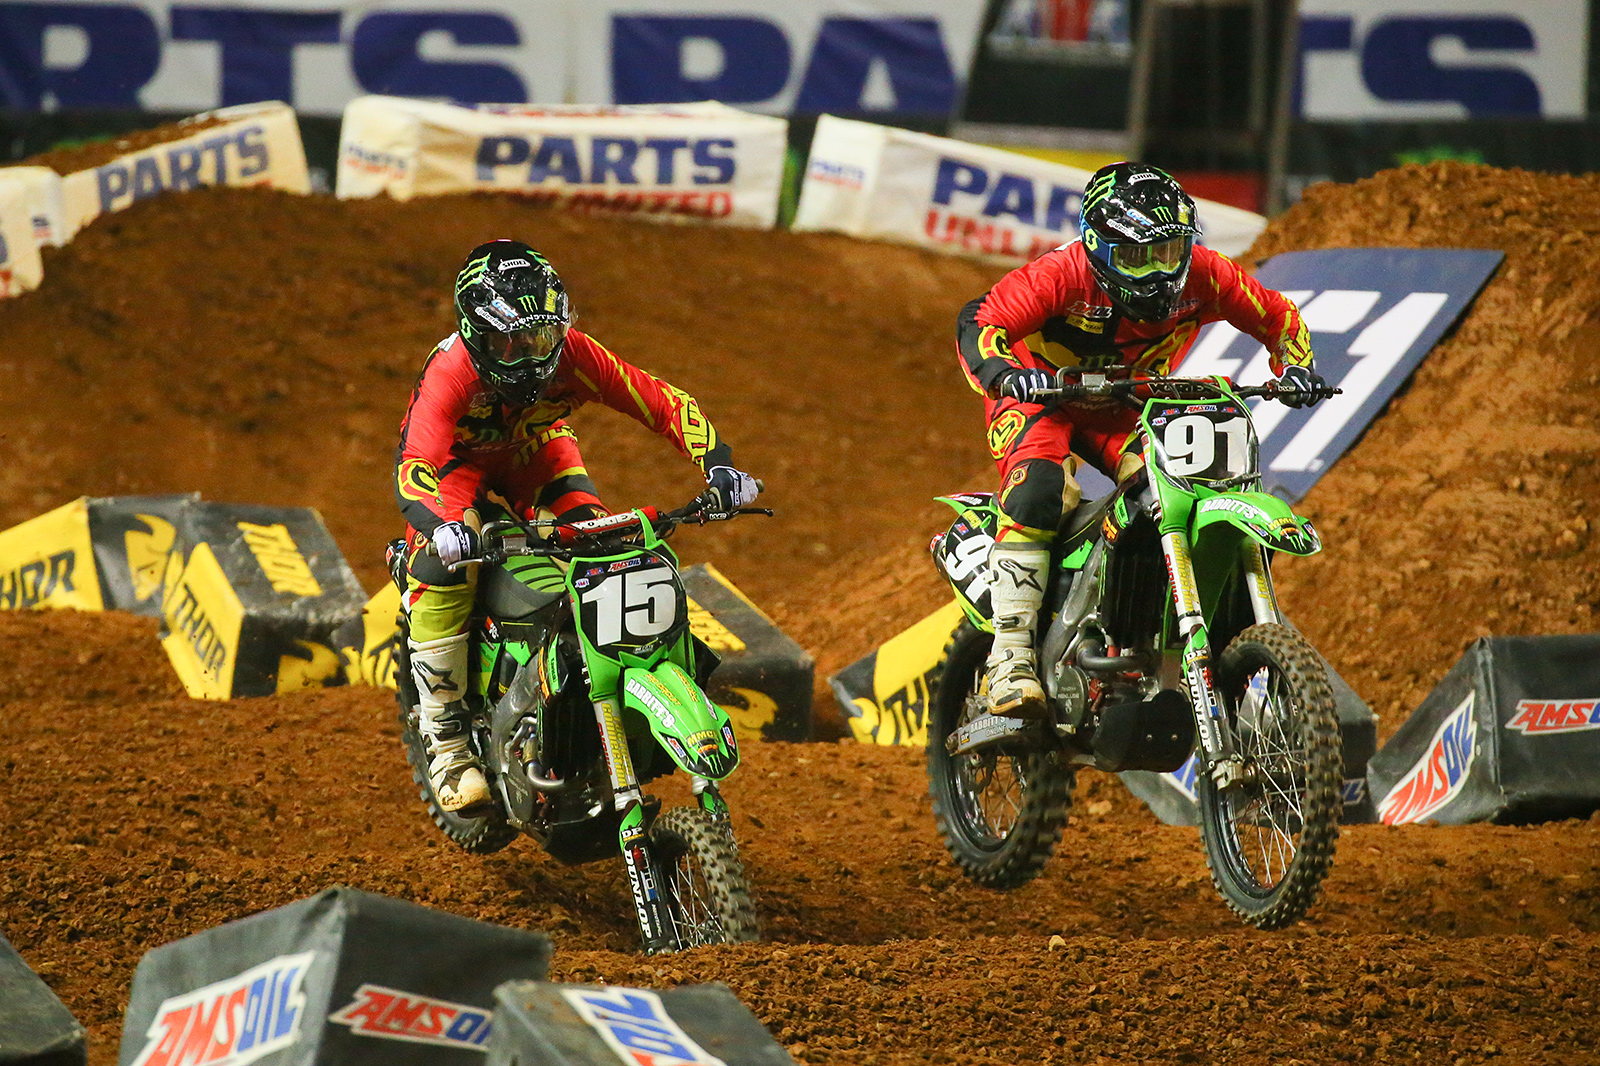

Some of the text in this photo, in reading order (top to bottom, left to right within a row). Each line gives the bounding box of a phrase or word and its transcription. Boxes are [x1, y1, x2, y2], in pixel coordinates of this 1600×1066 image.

[97, 124, 270, 212] PARTS
[475, 136, 737, 187] PARTS
[1161, 408, 1180, 417] AMA
[1186, 405, 1217, 413] AMSOIL
[1164, 415, 1247, 477] 91
[585, 567, 604, 577] AMA
[610, 558, 641, 572] AMSOIL
[582, 567, 676, 647] 15
[1187, 671, 1213, 753] DUNLOP
[1383, 704, 1475, 825] AMSOIL
[622, 826, 643, 839] DP
[624, 849, 652, 938] DUNLOP
[143, 967, 300, 1066] AMSOIL
